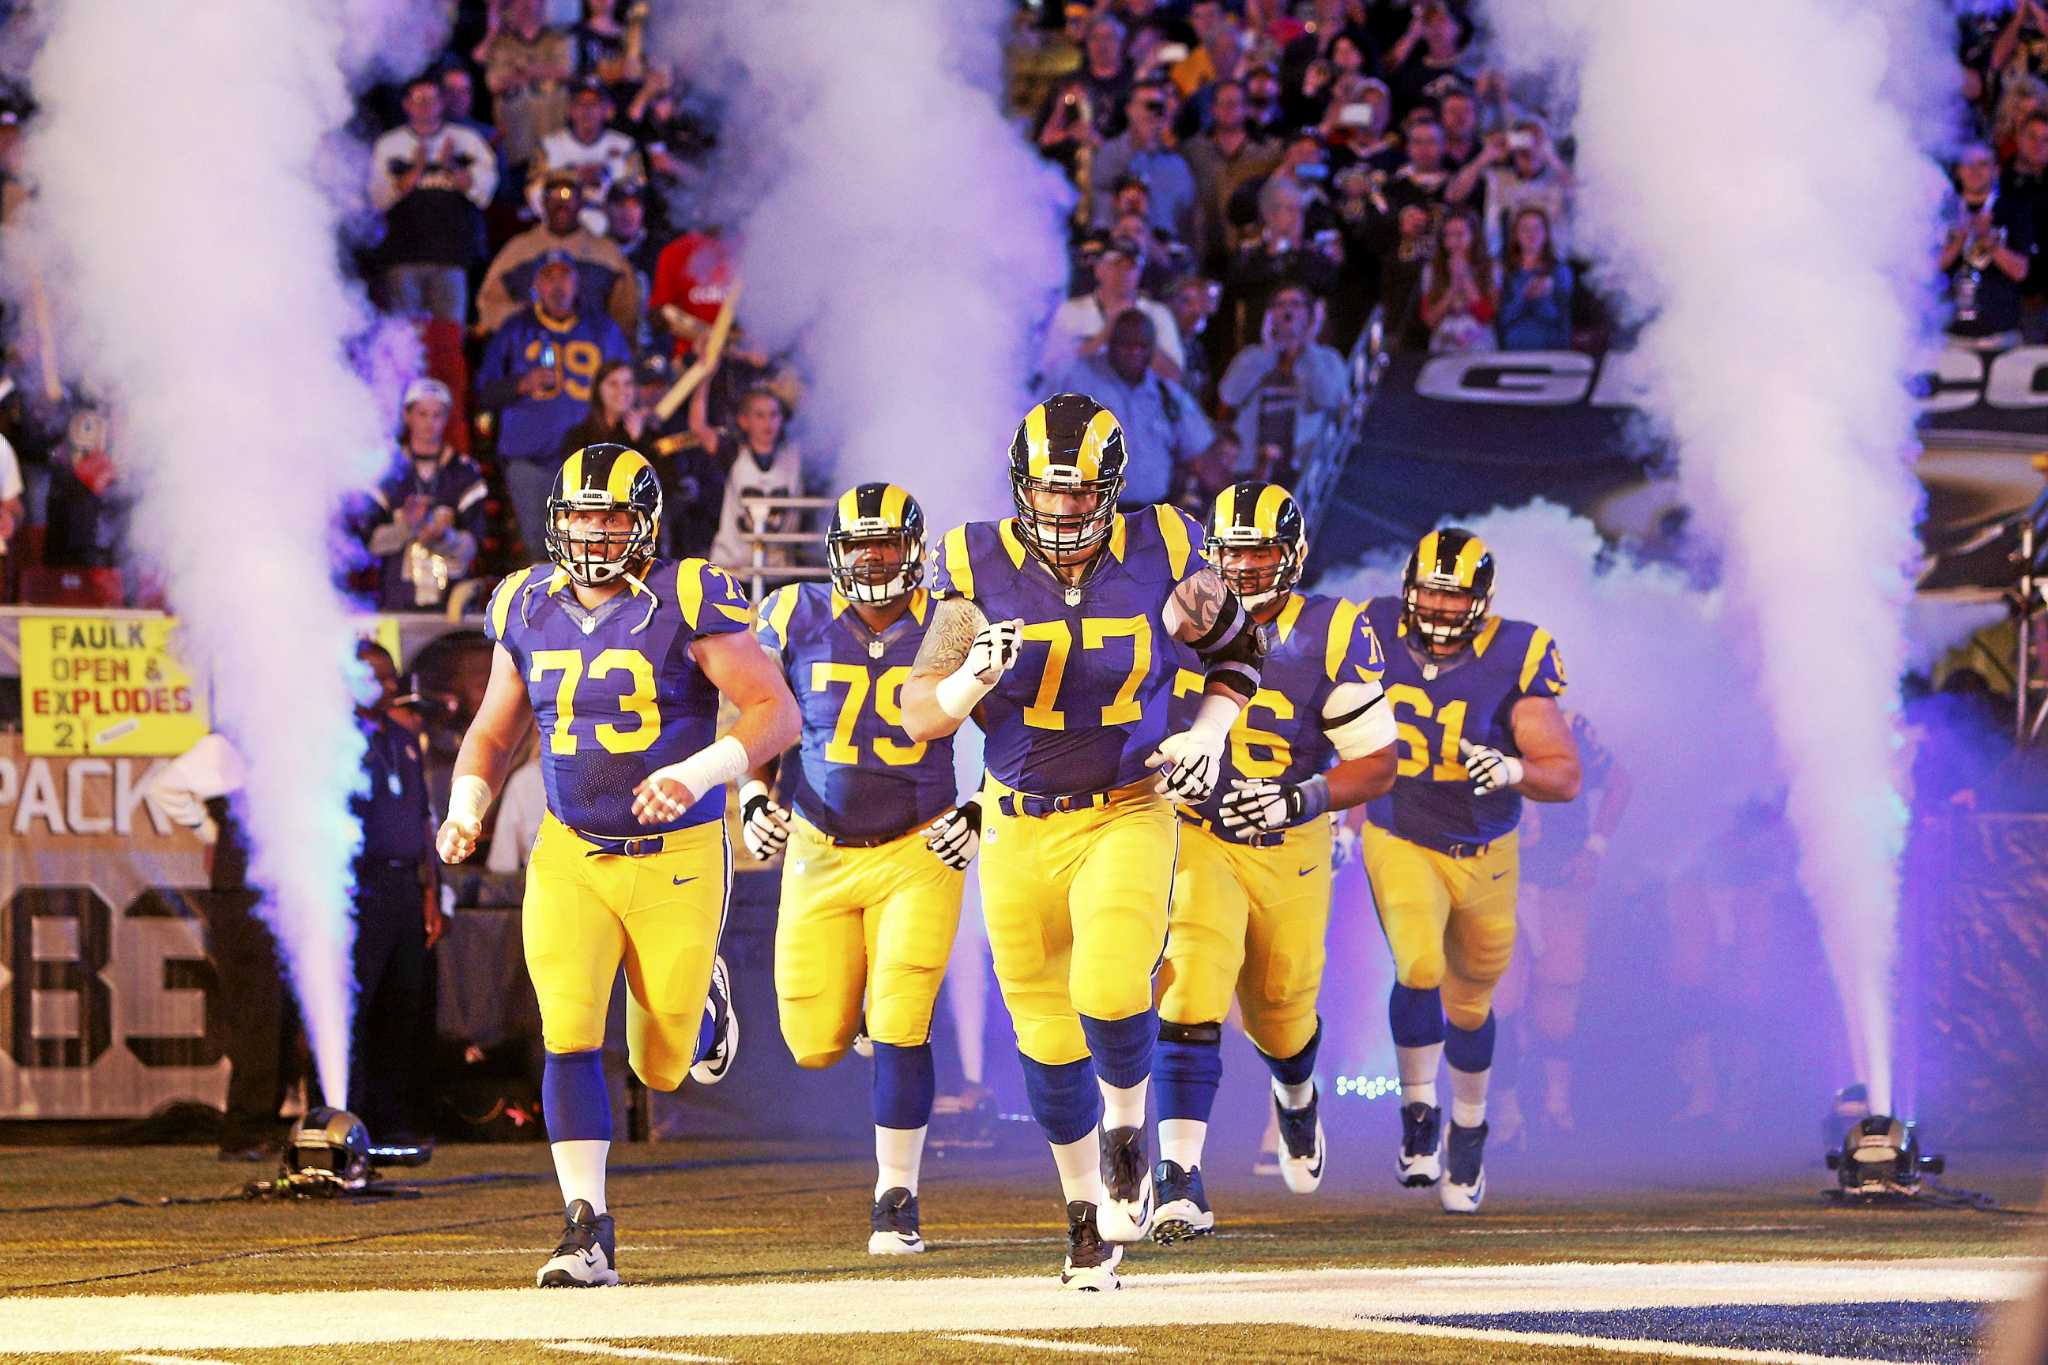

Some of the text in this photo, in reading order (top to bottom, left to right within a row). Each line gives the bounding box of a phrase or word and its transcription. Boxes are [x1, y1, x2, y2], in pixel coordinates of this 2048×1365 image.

[52, 625, 145, 649] FAULK
[52, 657, 162, 682] OPEN &
[1022, 613, 1152, 730] 77
[33, 685, 192, 715] EXPLODES
[529, 648, 661, 755] 73
[811, 662, 928, 766] 79
[1384, 682, 1469, 781] 61
